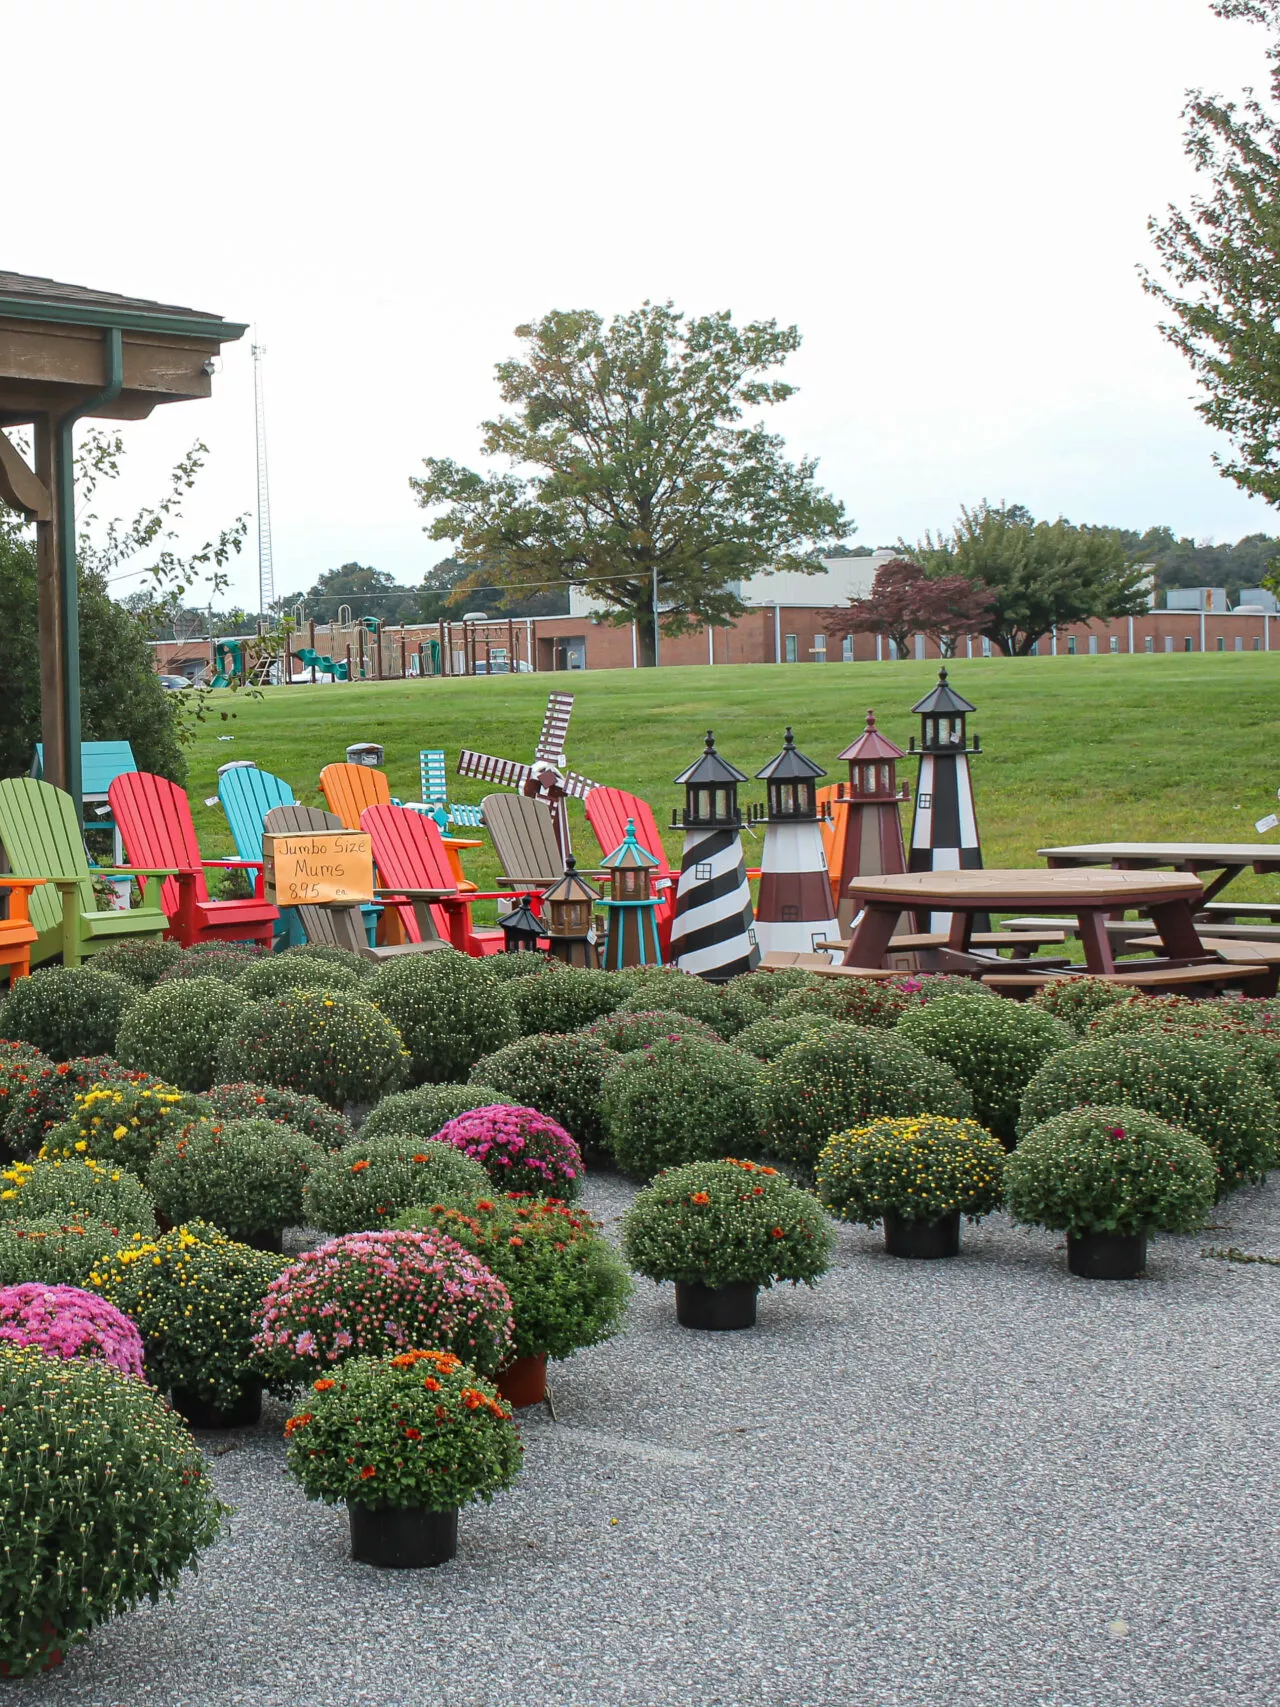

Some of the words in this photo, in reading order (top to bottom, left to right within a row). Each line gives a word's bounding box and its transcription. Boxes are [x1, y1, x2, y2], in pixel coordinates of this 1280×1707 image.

[279, 838, 327, 855] Jumbo
[332, 837, 366, 853] Size
[295, 859, 345, 877] Mums
[289, 882, 320, 900] 8.95
